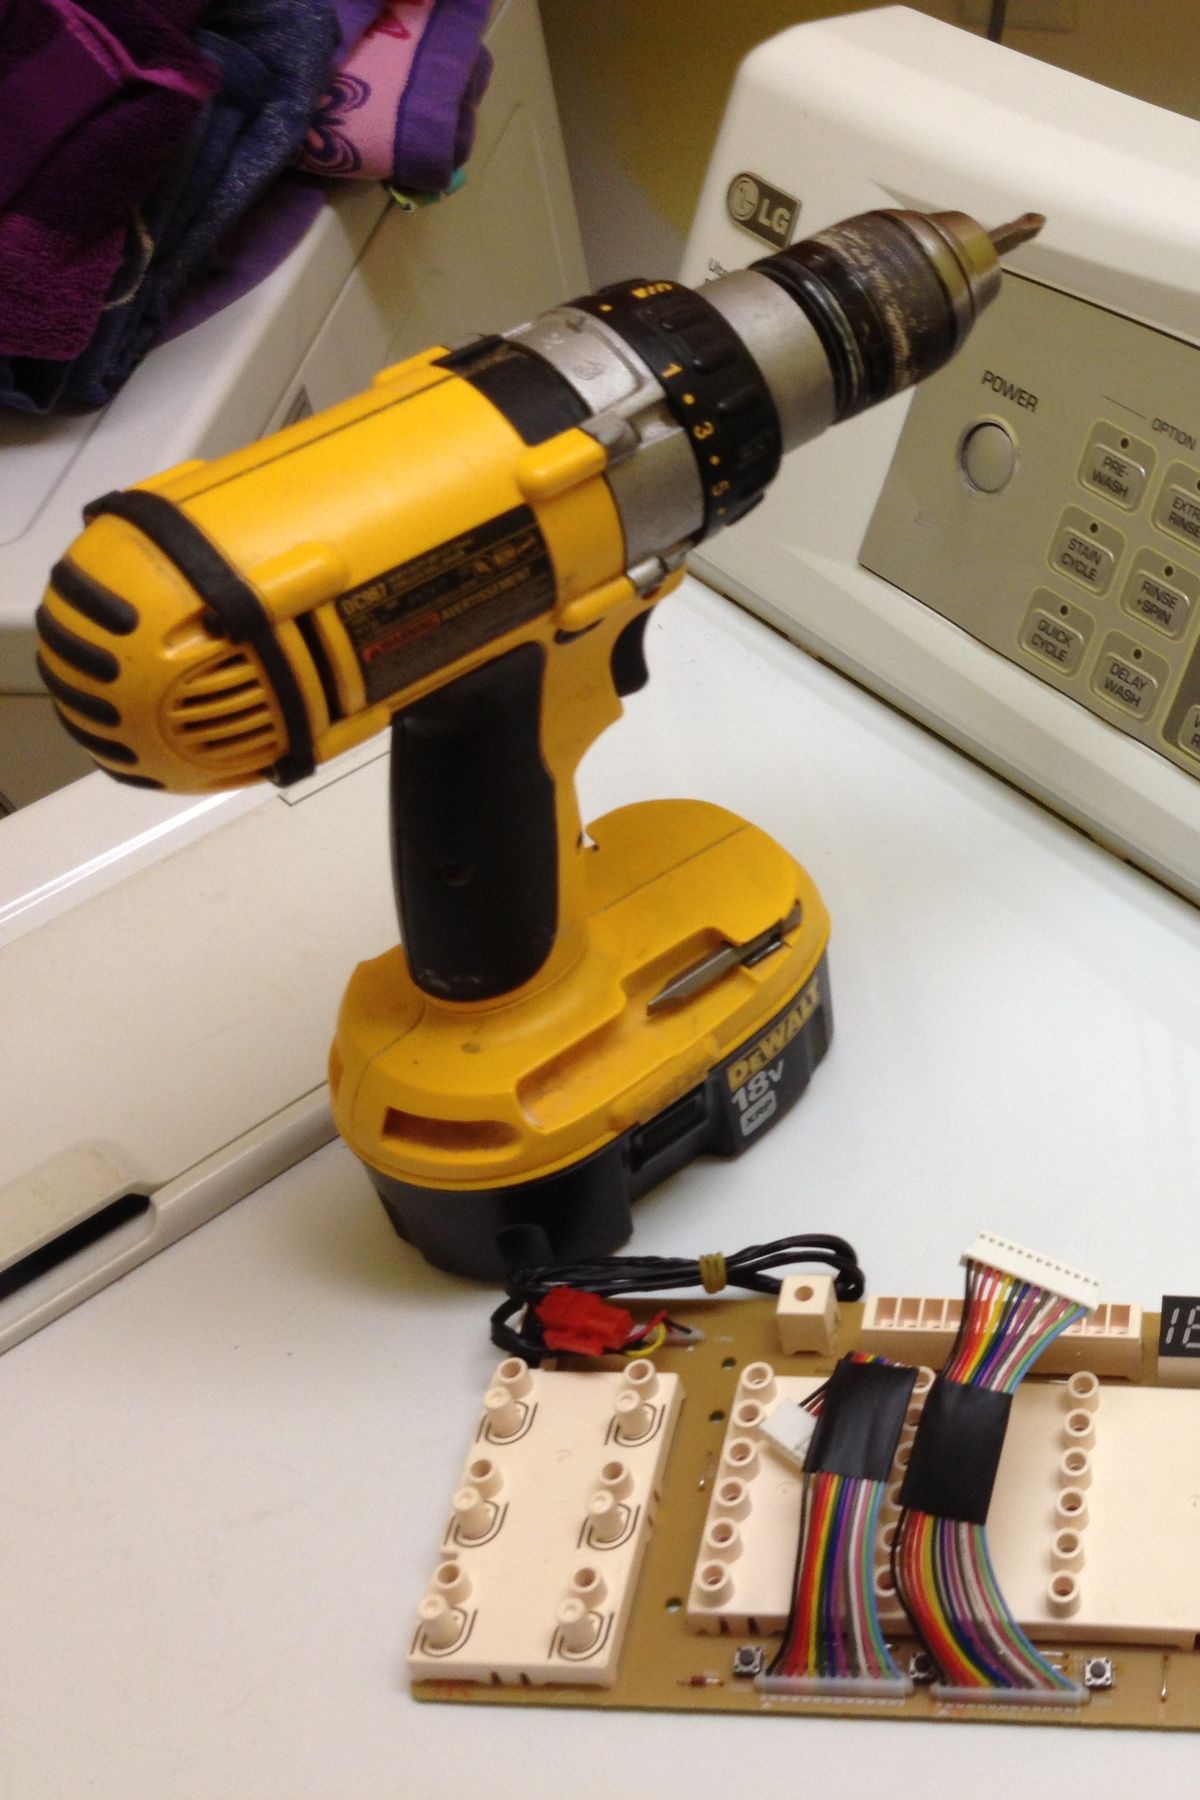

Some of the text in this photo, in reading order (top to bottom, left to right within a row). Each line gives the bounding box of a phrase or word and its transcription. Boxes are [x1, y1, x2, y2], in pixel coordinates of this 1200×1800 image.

[758, 198, 791, 236] LG
[981, 370, 1040, 413] POWER
[1152, 417, 1197, 451] OPTION
[1092, 469, 1129, 498] WASH
[1067, 537, 1101, 566] STAIN
[1060, 553, 1099, 582] CYCLE
[1140, 580, 1180, 610] RINSE
[1029, 632, 1068, 663] CYCLE
[1036, 618, 1075, 648] QUICK
[1103, 676, 1142, 709] WASH
[1109, 662, 1149, 693] DELAY
